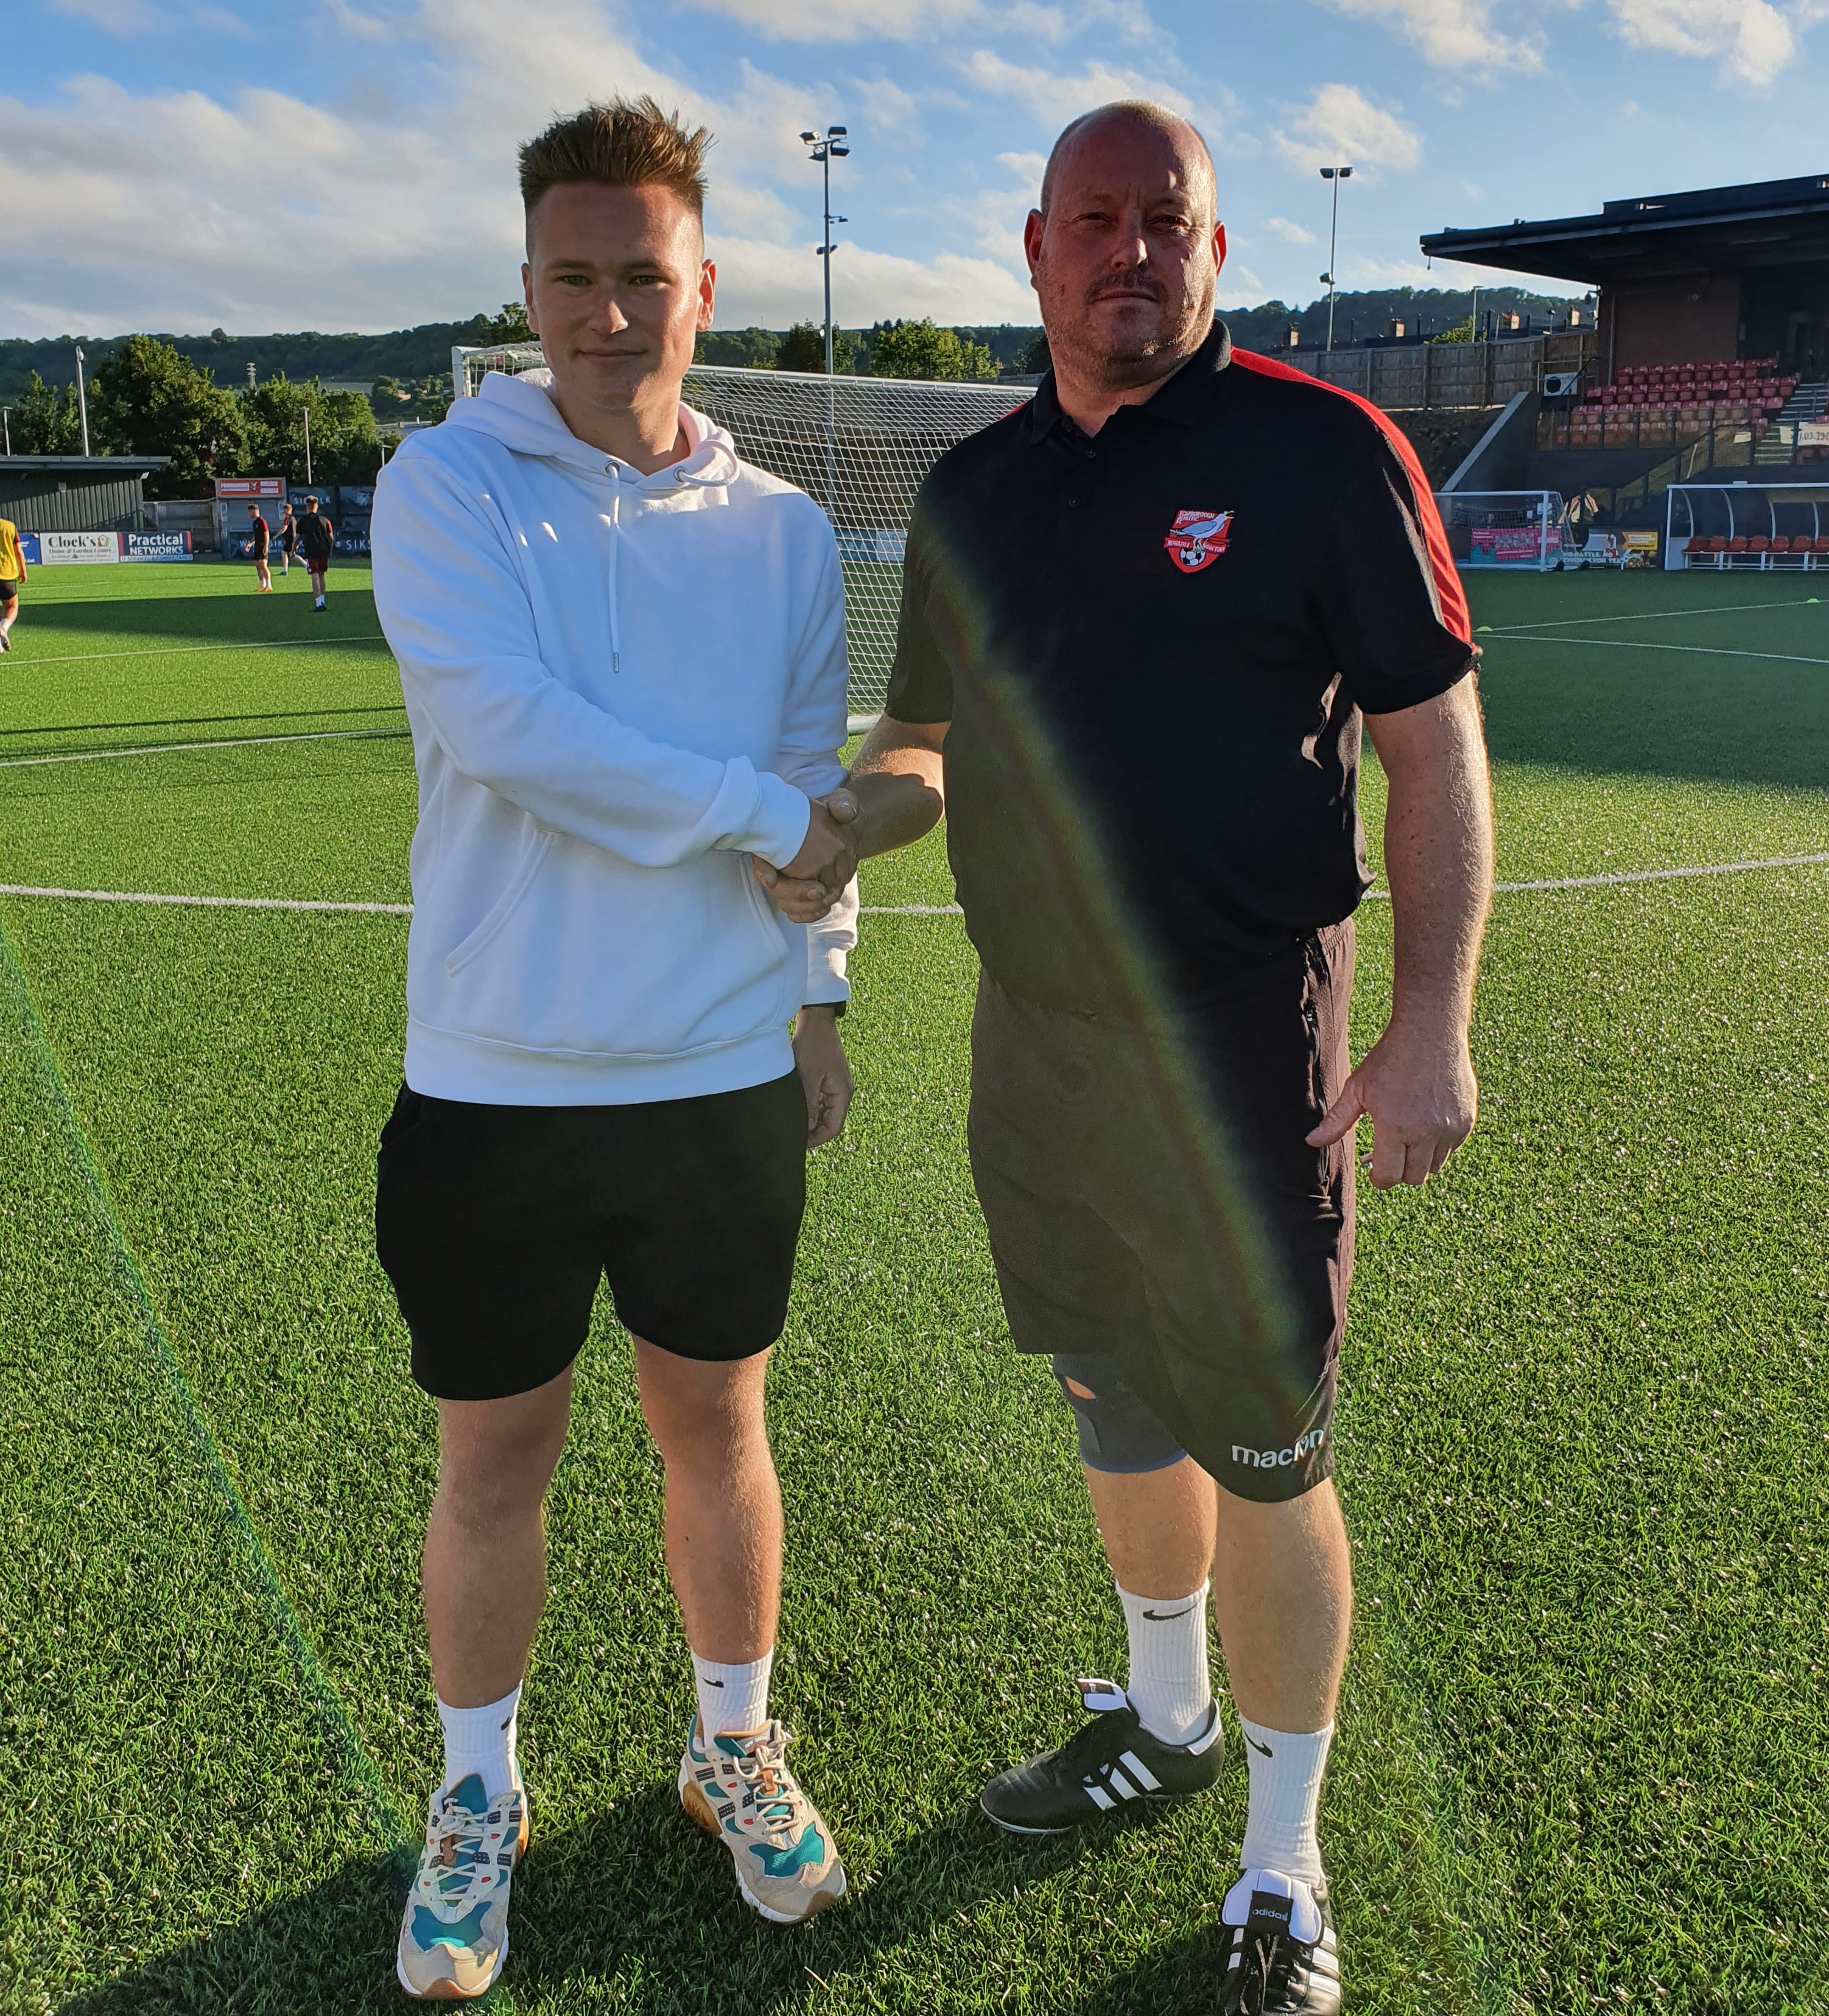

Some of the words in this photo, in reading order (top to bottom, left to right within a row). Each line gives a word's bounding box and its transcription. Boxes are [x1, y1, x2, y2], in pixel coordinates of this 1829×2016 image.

[293, 495, 331, 505] SILK
[48, 535, 97, 548] Clock's
[128, 533, 183, 546] Practical
[130, 545, 184, 555] NETWORKS
[1252, 1908, 1288, 1922] adidas
